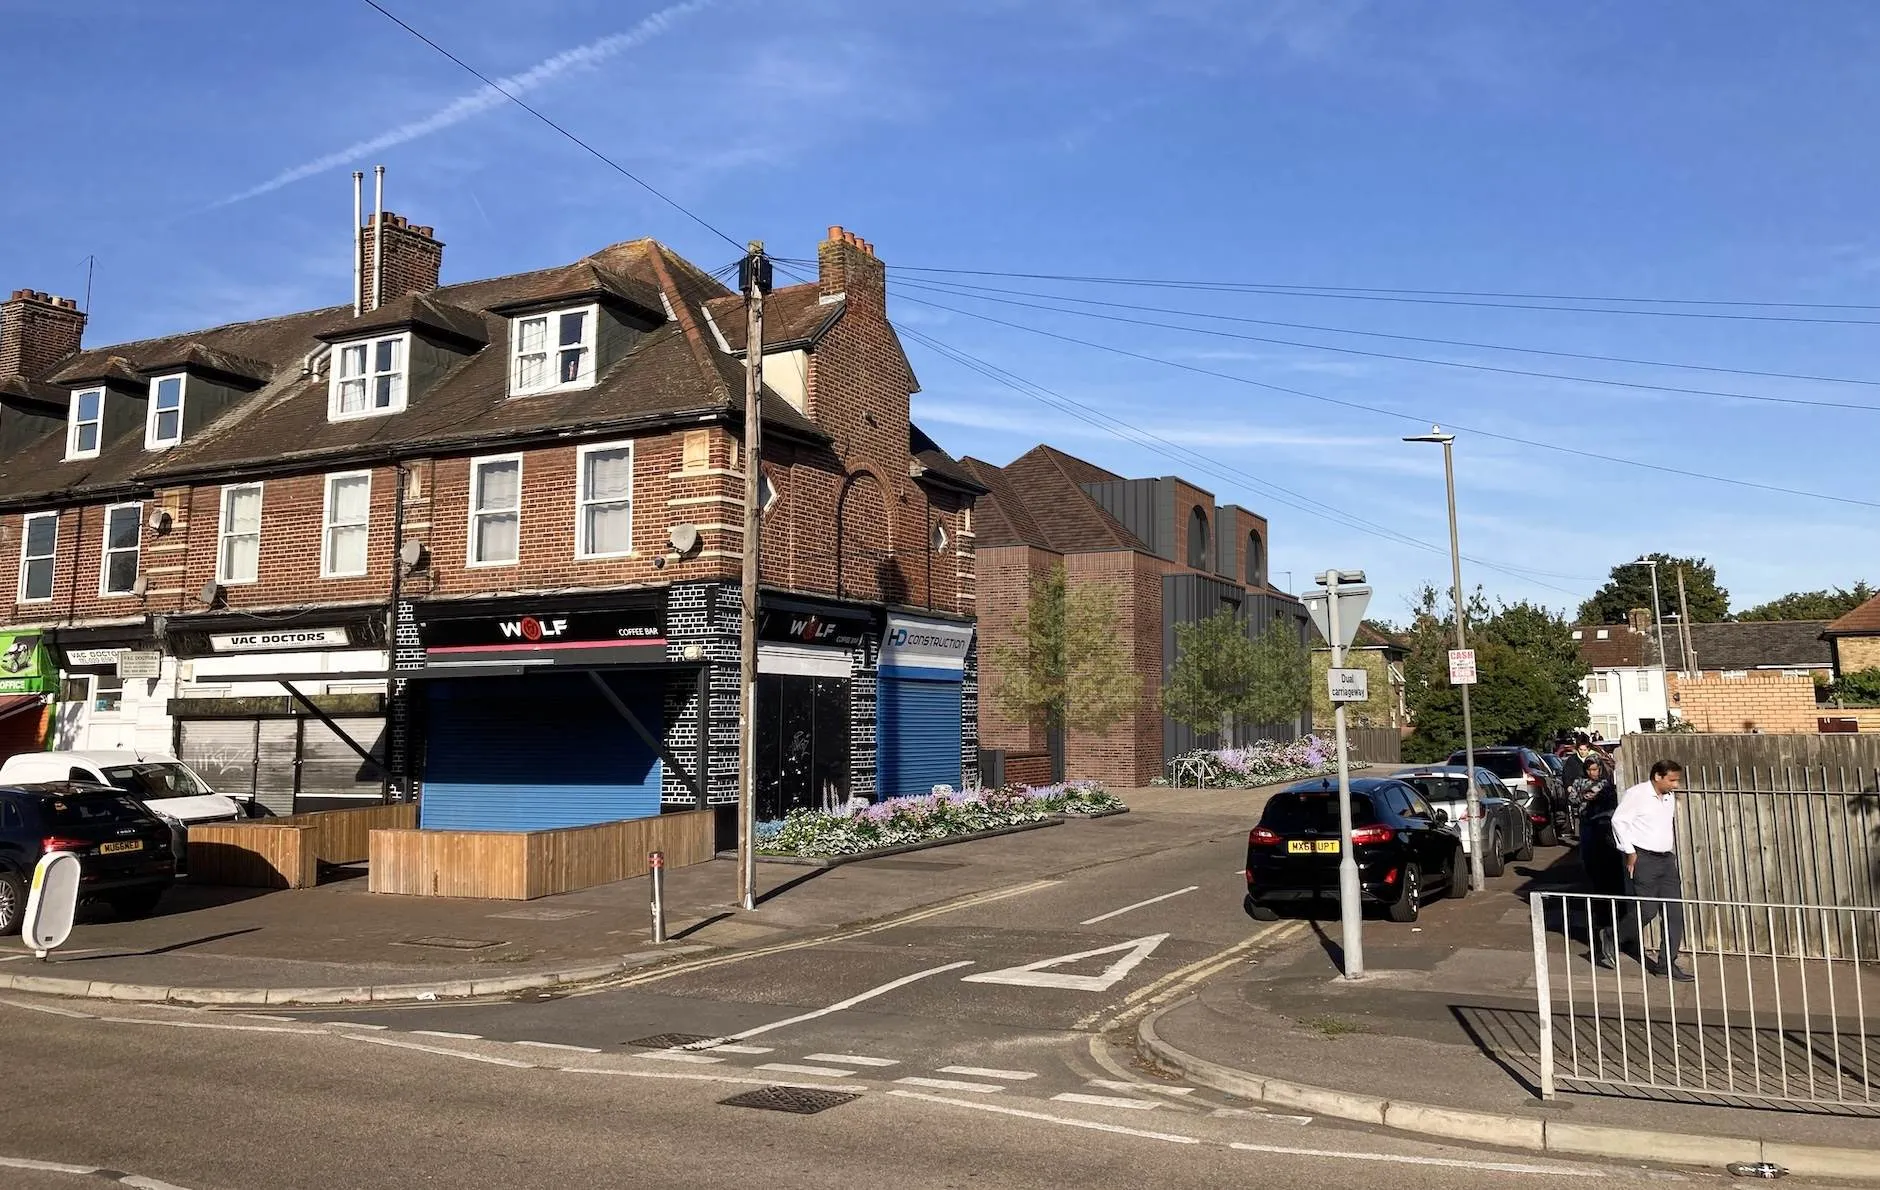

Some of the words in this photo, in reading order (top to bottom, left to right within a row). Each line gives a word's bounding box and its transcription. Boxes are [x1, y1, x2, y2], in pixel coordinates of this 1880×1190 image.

[499, 617, 568, 641] WOLF
[618, 628, 643, 637] COFFEE
[644, 627, 659, 636] BAR
[231, 637, 258, 645] VAC
[261, 632, 325, 643] DOCTORS
[887, 628, 908, 647] HD
[907, 634, 966, 650] CONSTRUCTION
[1450, 651, 1474, 660] CASH
[1341, 673, 1355, 683] Dual
[0, 680, 25, 690] OFFICE
[1331, 687, 1365, 698] carriageway
